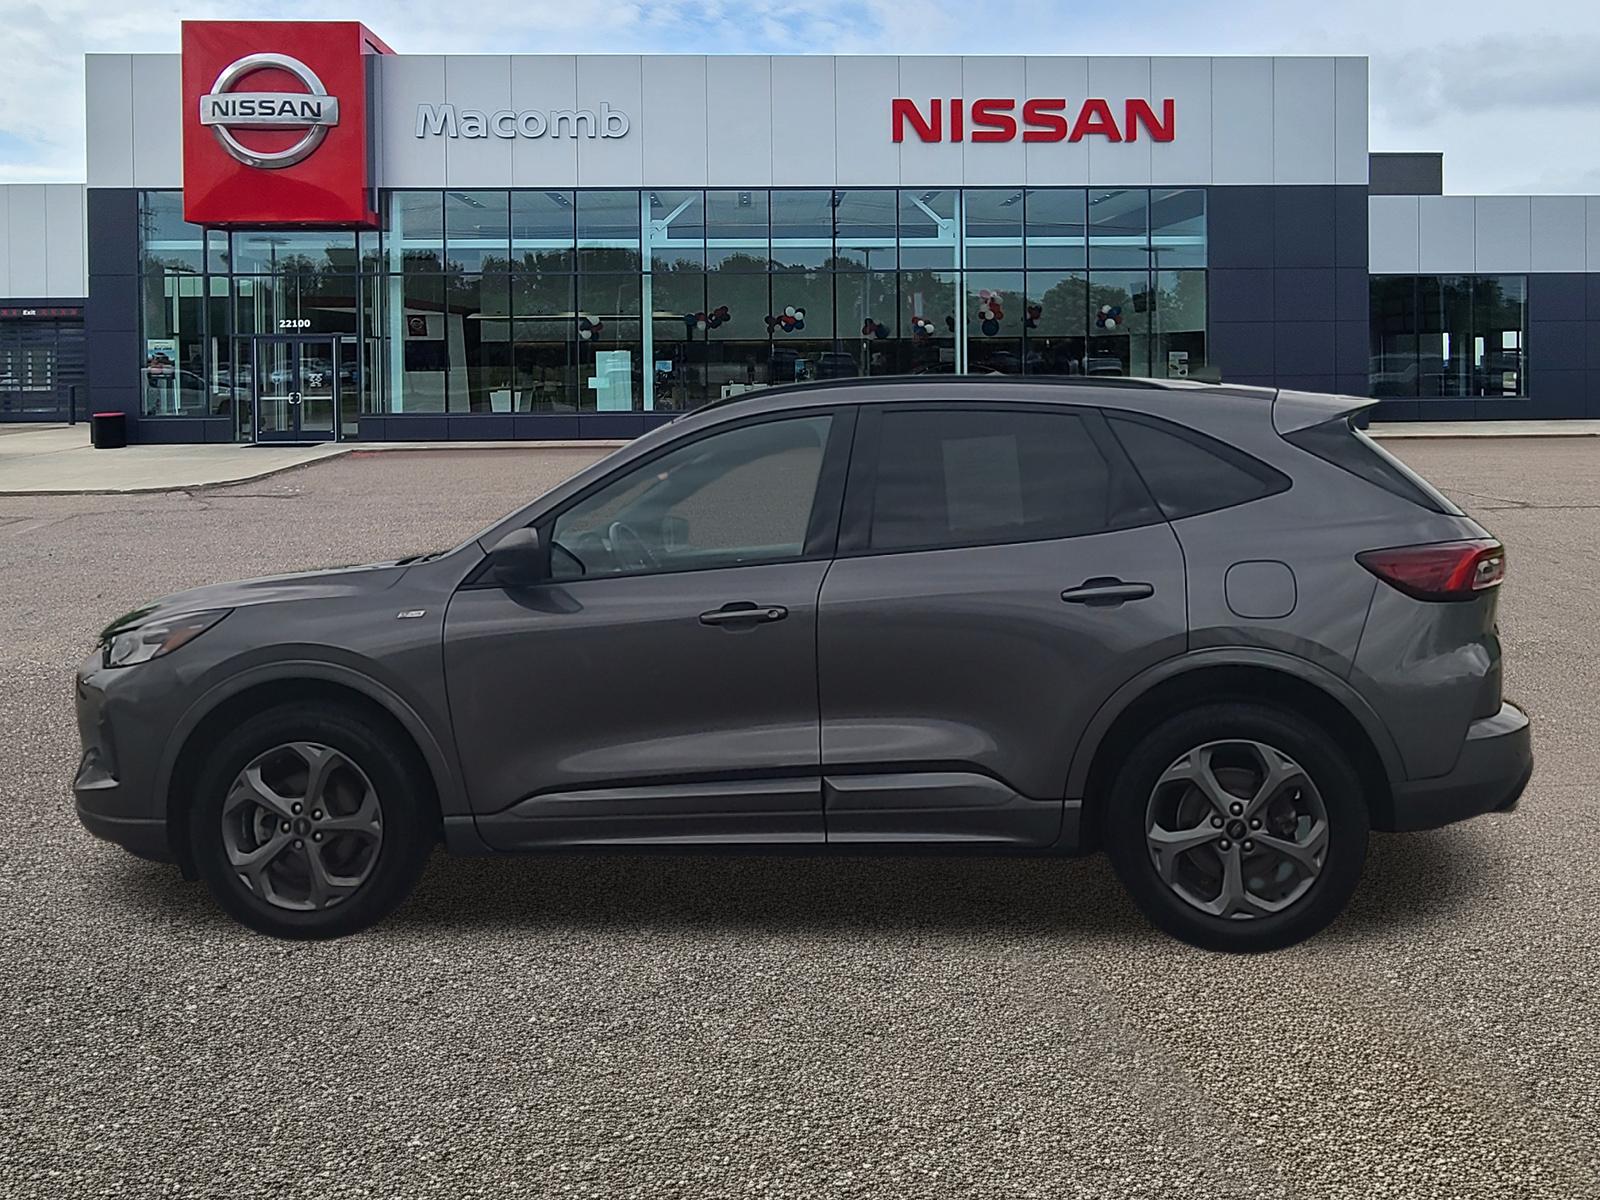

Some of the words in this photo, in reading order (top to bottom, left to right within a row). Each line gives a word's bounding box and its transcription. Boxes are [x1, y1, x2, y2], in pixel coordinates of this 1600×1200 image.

[212, 100, 321, 117] NISSAN
[415, 102, 630, 138] Macomb
[892, 98, 1175, 142] NISSAN
[279, 319, 311, 328] 22100
